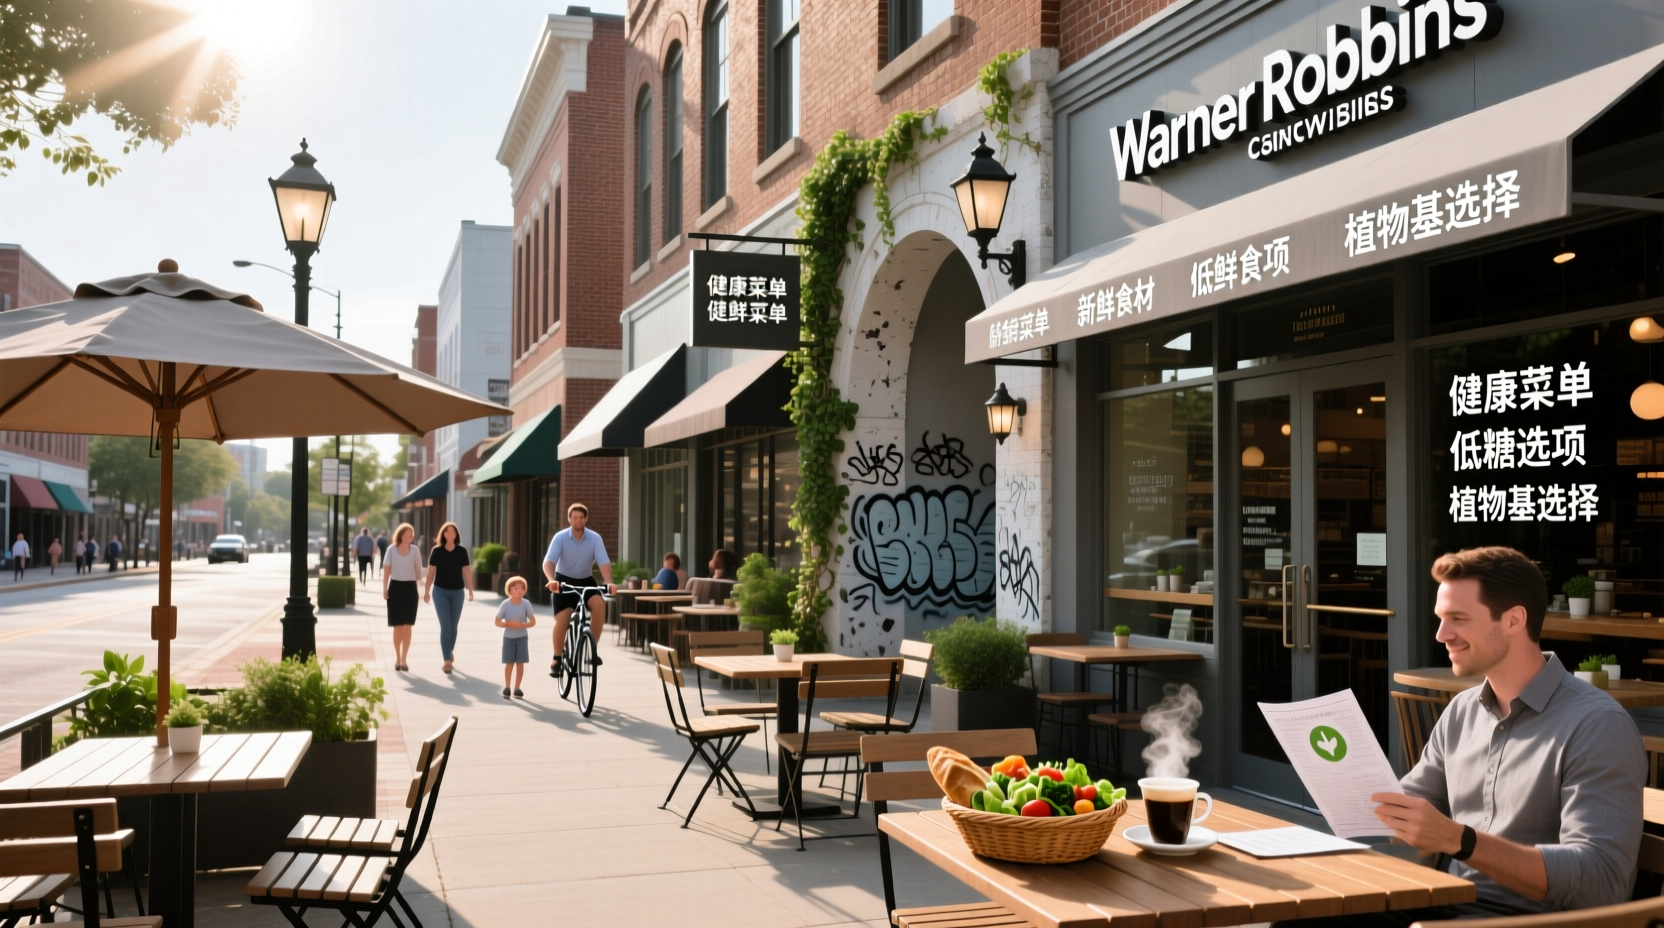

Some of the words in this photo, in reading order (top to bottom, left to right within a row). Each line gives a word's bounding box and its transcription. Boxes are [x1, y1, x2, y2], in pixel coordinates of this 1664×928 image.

[1110, 80, 1256, 181] Warner
[1263, 0, 1487, 121] Robbins
[1344, 169, 1521, 257] 植物基选择
[707, 274, 787, 299] 健康菜单
[1190, 235, 1290, 298] 低鲜食项
[1077, 275, 1155, 327] 新鲜食材
[1449, 361, 1594, 417] 健康菜单
[1449, 424, 1587, 472] 低糖选项
[1448, 483, 1599, 523] 植物基选择
